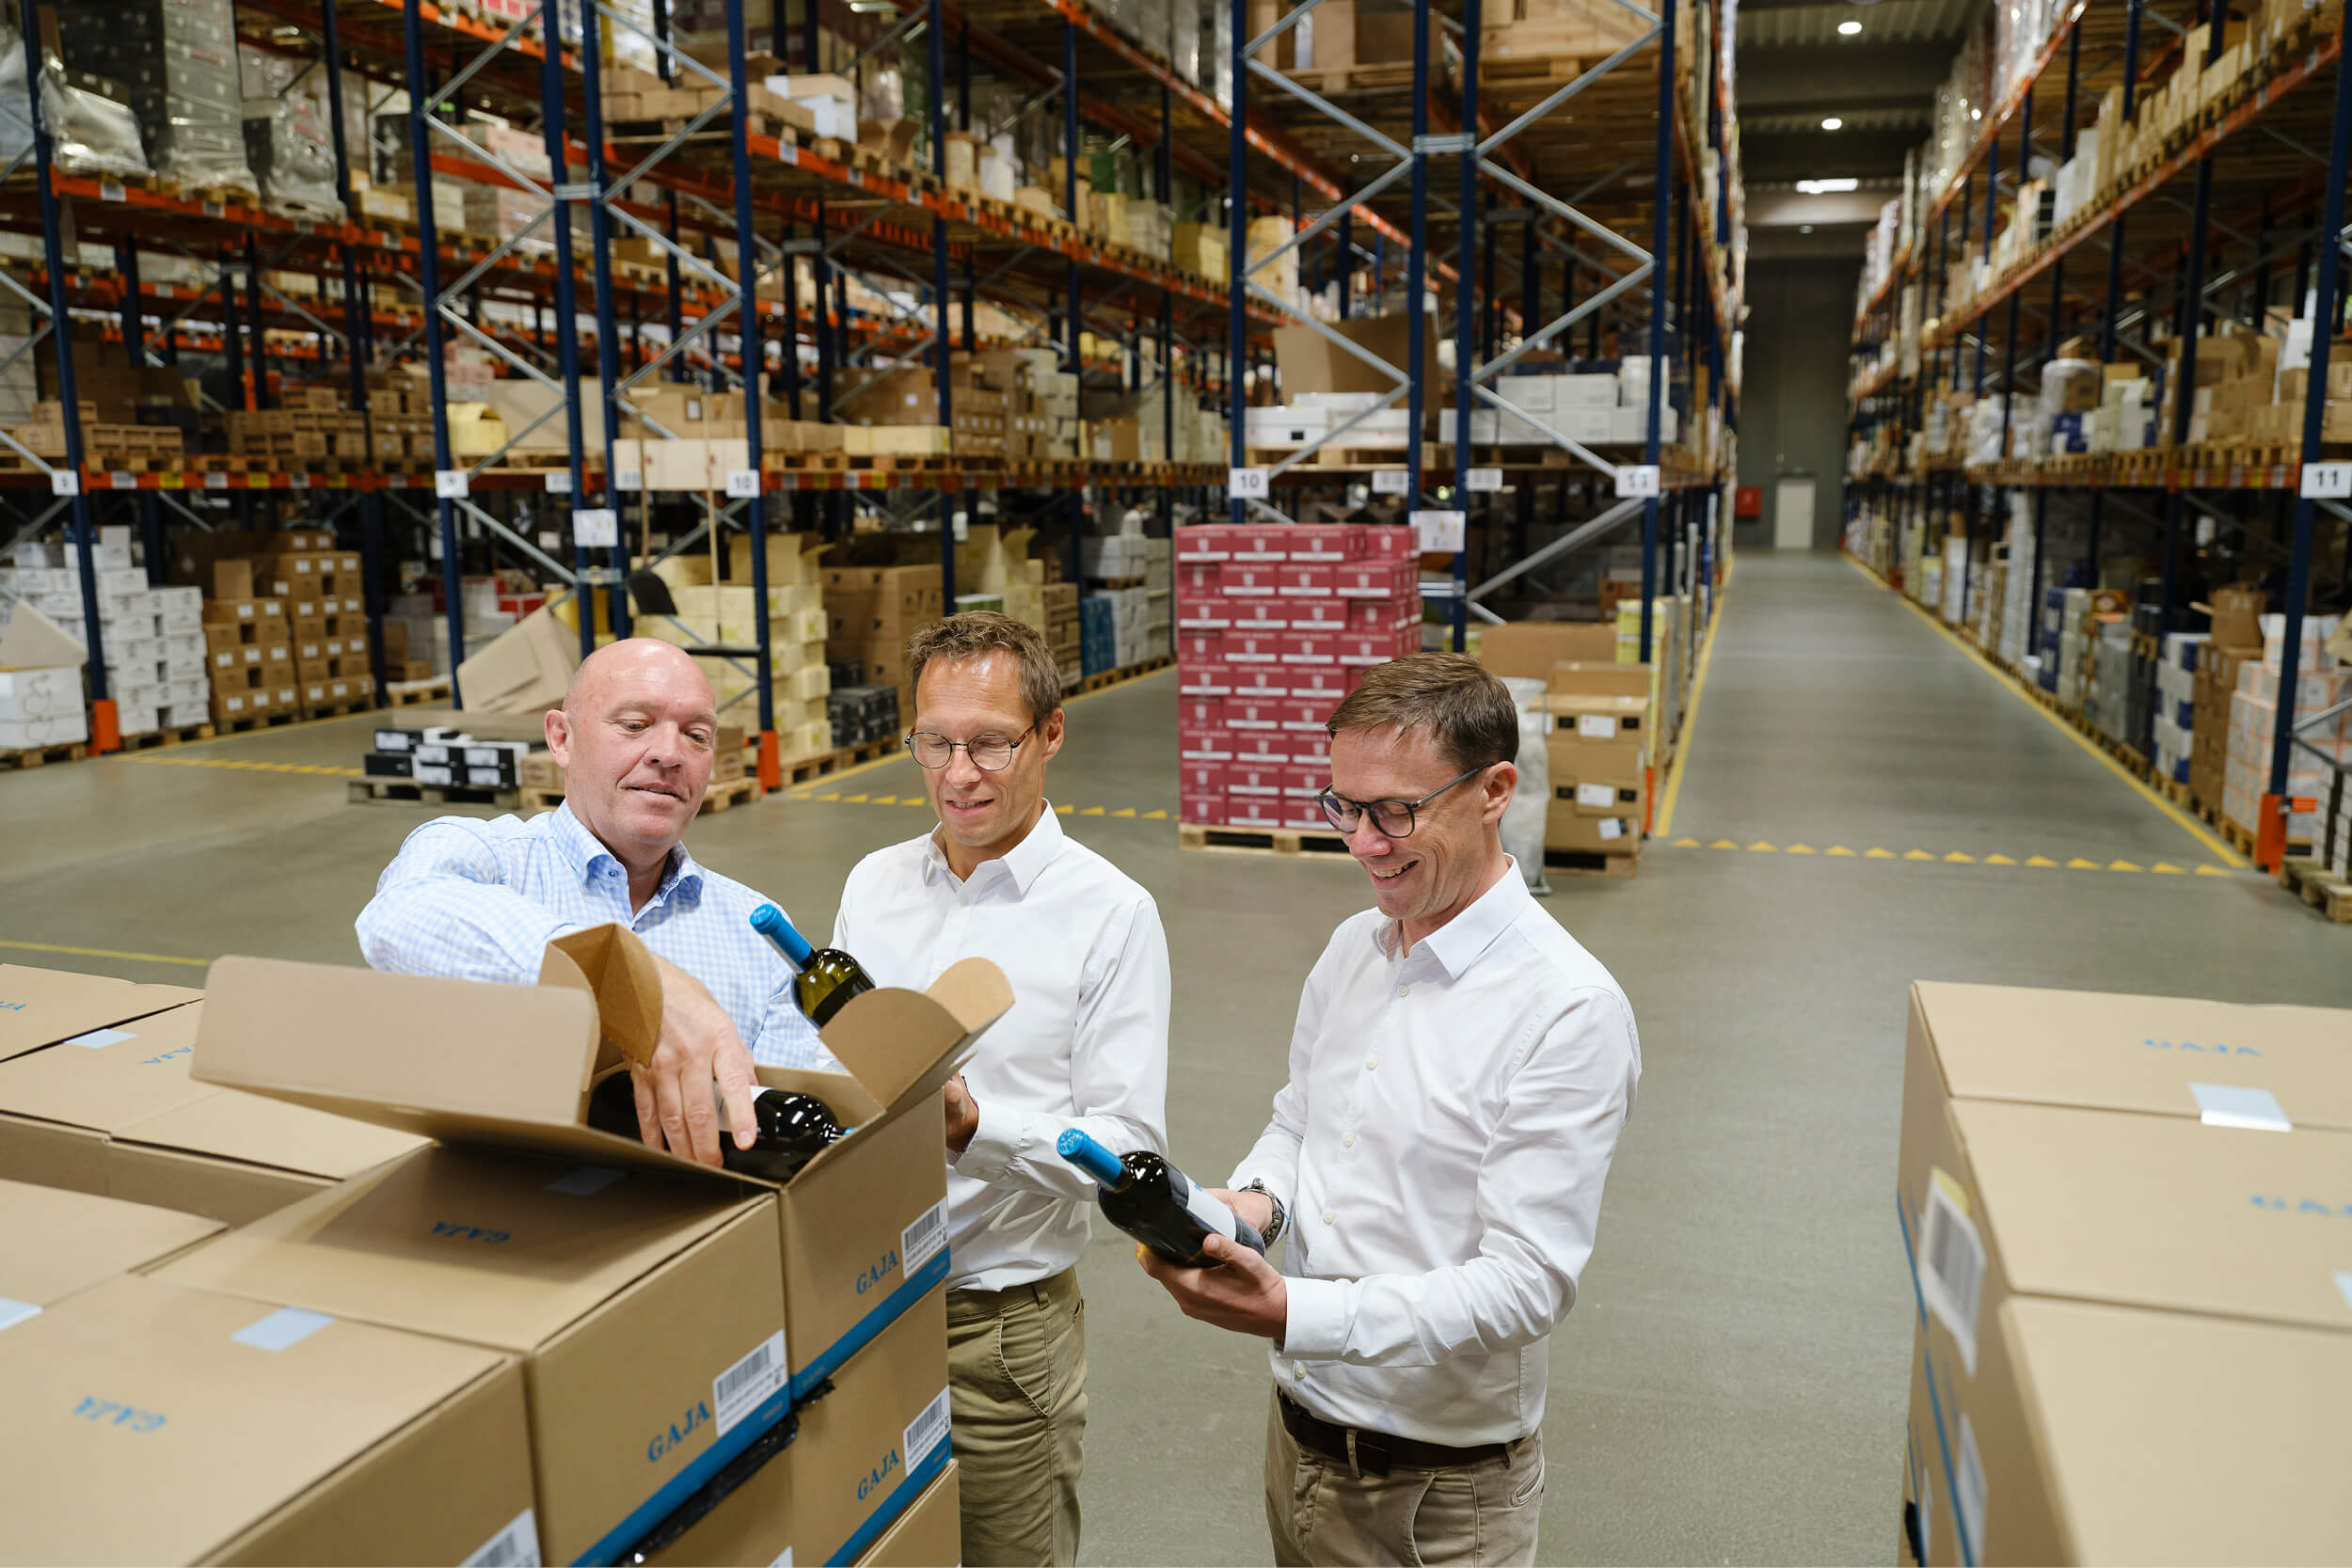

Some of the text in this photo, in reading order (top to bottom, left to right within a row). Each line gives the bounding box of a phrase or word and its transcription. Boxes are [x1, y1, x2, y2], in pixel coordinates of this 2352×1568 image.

[1239, 473, 1260, 489] 10
[2313, 469, 2339, 488] 11
[855, 1248, 898, 1295] GAJA
[646, 1400, 711, 1464] GAJA
[857, 1448, 900, 1501] GAJA
